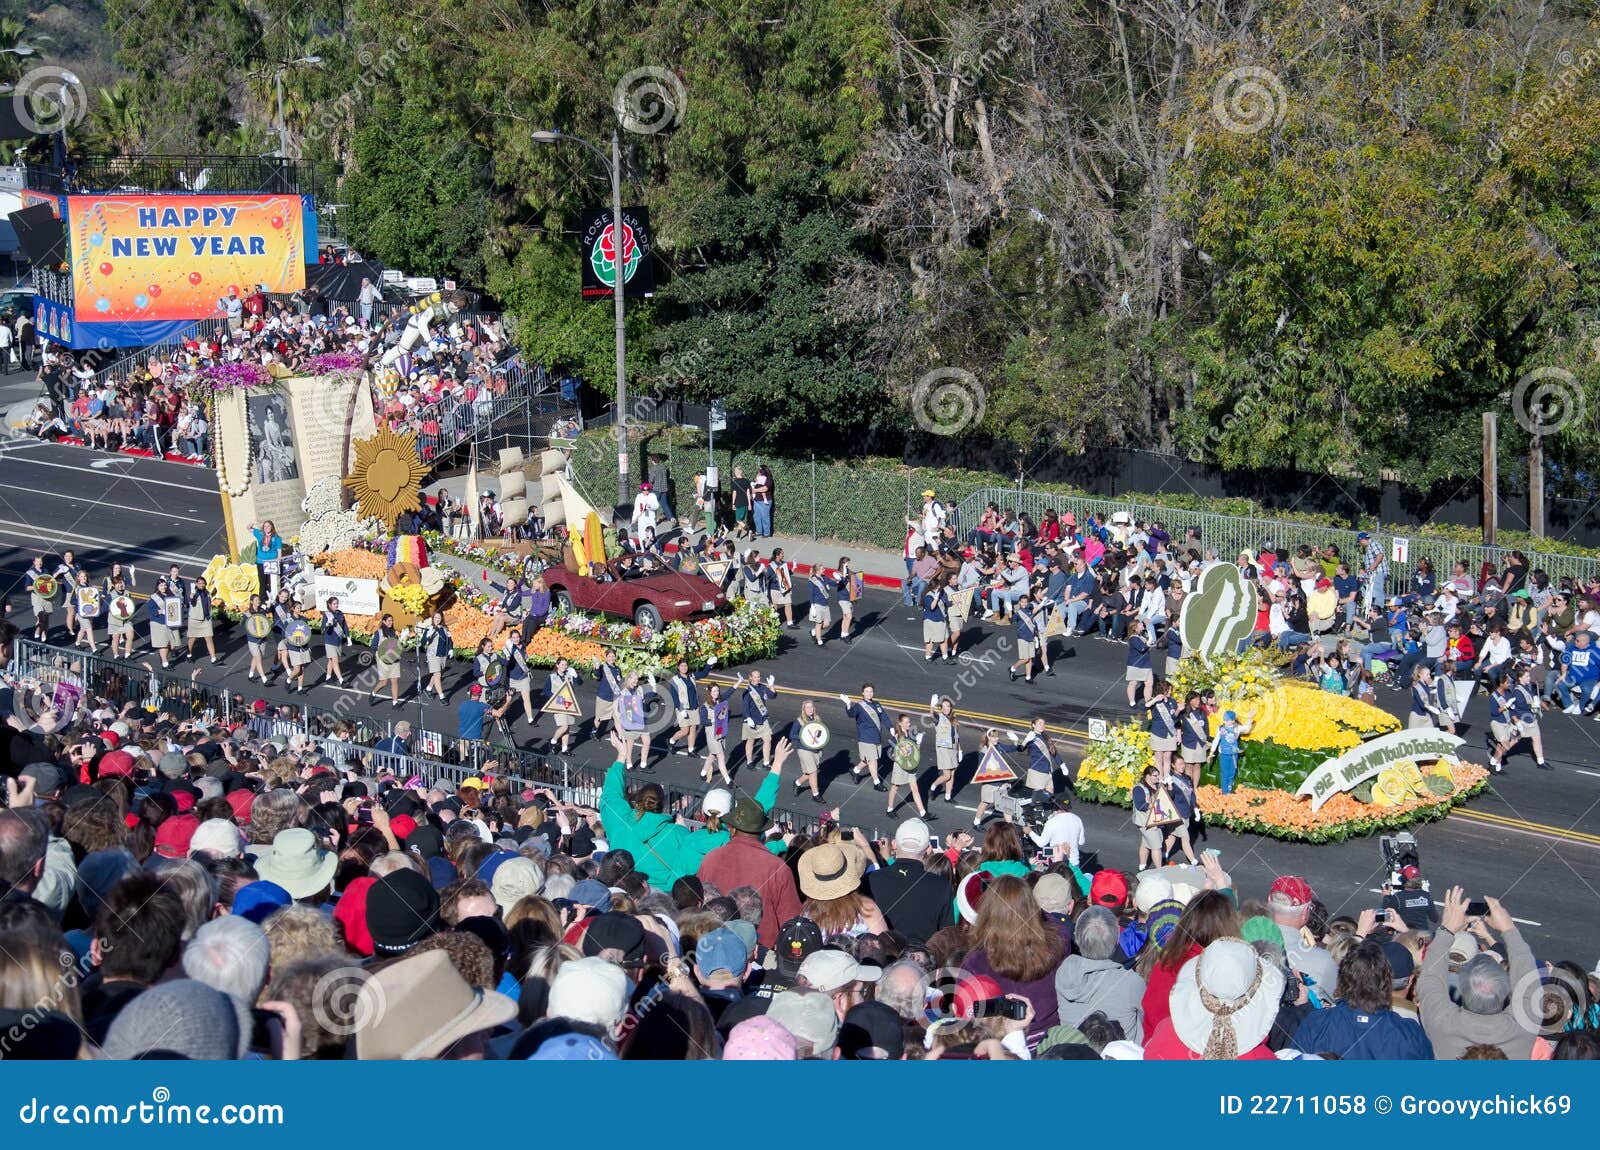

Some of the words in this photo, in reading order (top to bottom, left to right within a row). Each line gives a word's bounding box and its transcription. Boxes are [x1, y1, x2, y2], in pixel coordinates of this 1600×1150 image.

[138, 207, 238, 229] HAPPY
[583, 213, 610, 246] ROSE
[622, 213, 650, 253] ARADE
[112, 237, 178, 257] NEW
[190, 236, 267, 257] YEAR
[263, 561, 279, 574] 25
[1340, 756, 1369, 782] What
[1383, 744, 1401, 762] You
[1398, 741, 1413, 758] Do
[1313, 772, 1335, 798] 1912
